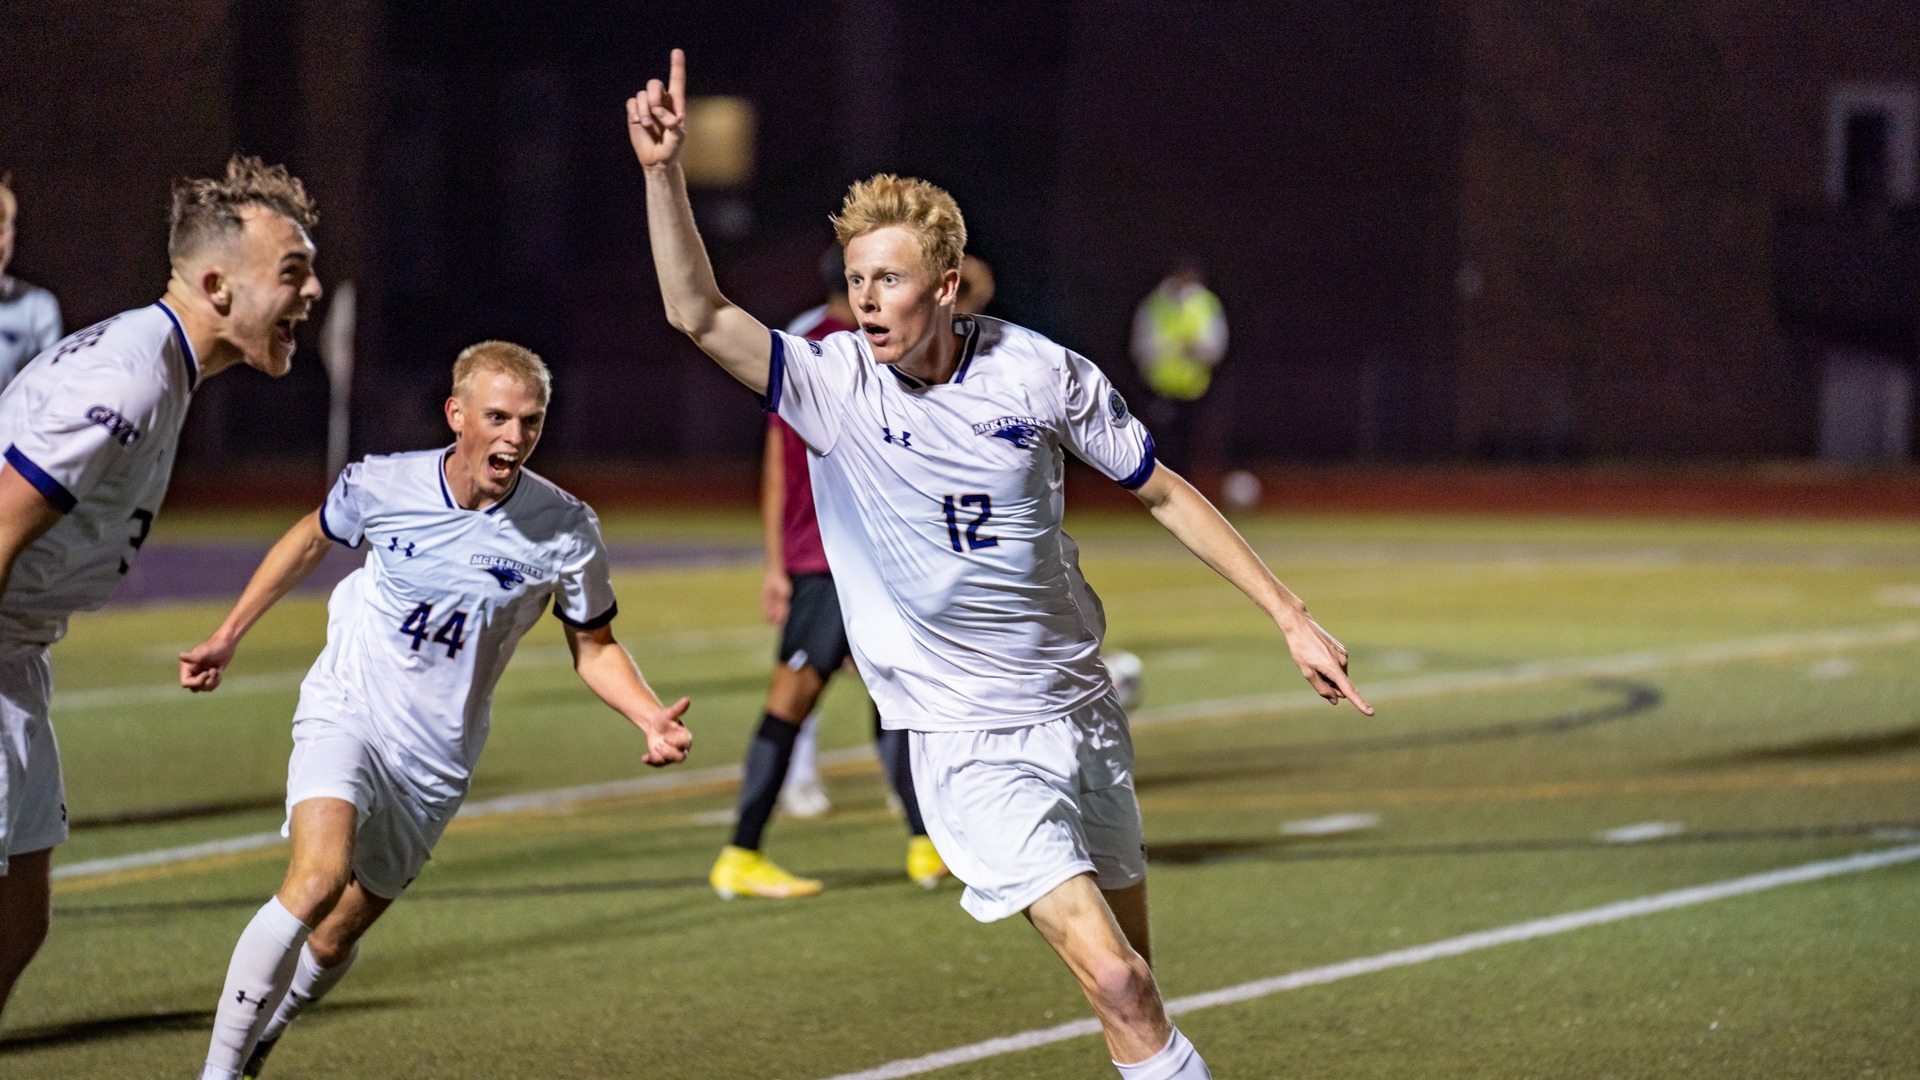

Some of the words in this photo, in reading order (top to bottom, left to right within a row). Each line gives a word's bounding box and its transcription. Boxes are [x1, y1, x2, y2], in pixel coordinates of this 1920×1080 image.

[942, 493, 999, 553] 12
[470, 554, 544, 580] McKENDREE
[399, 601, 469, 660] 44
